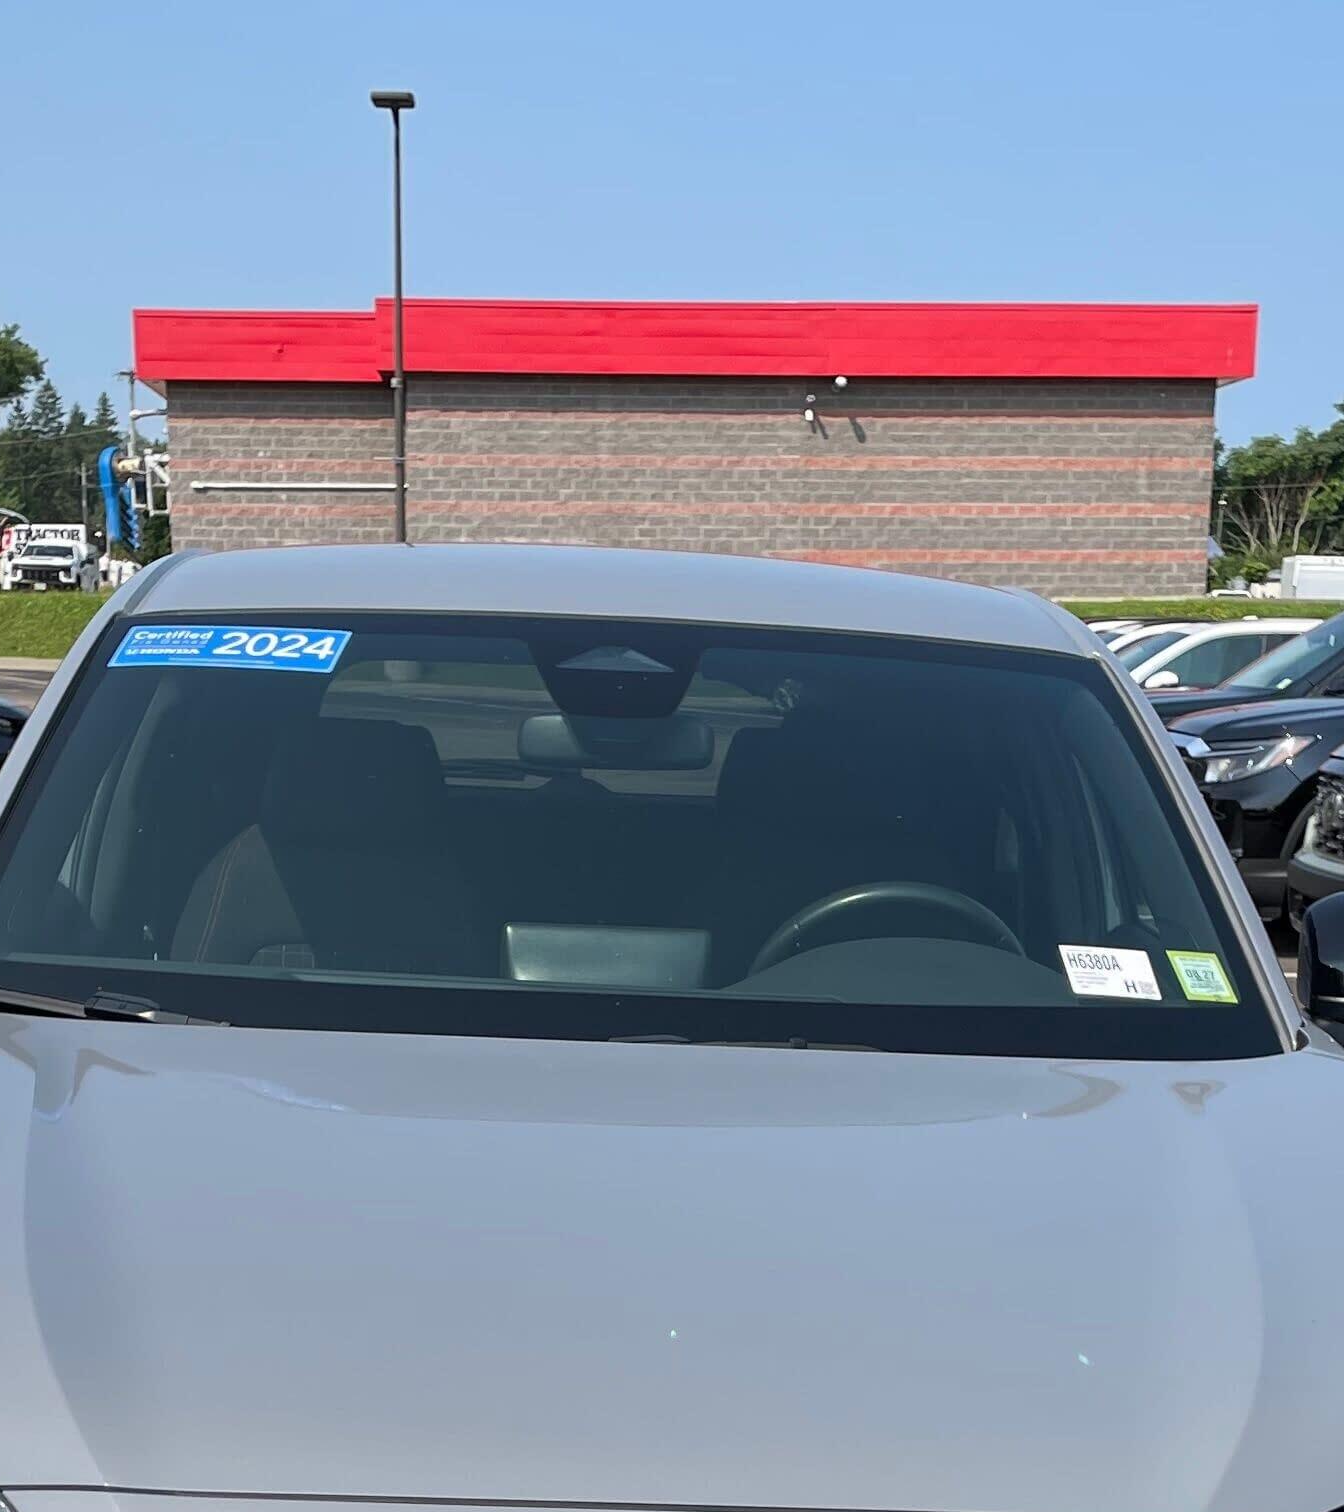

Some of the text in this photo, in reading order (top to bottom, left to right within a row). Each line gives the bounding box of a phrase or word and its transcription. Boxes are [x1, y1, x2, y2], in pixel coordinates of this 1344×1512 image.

[133, 629, 336, 660] Certified 2024
[1066, 952, 1123, 972] H6380A
[1124, 979, 1139, 994] H
